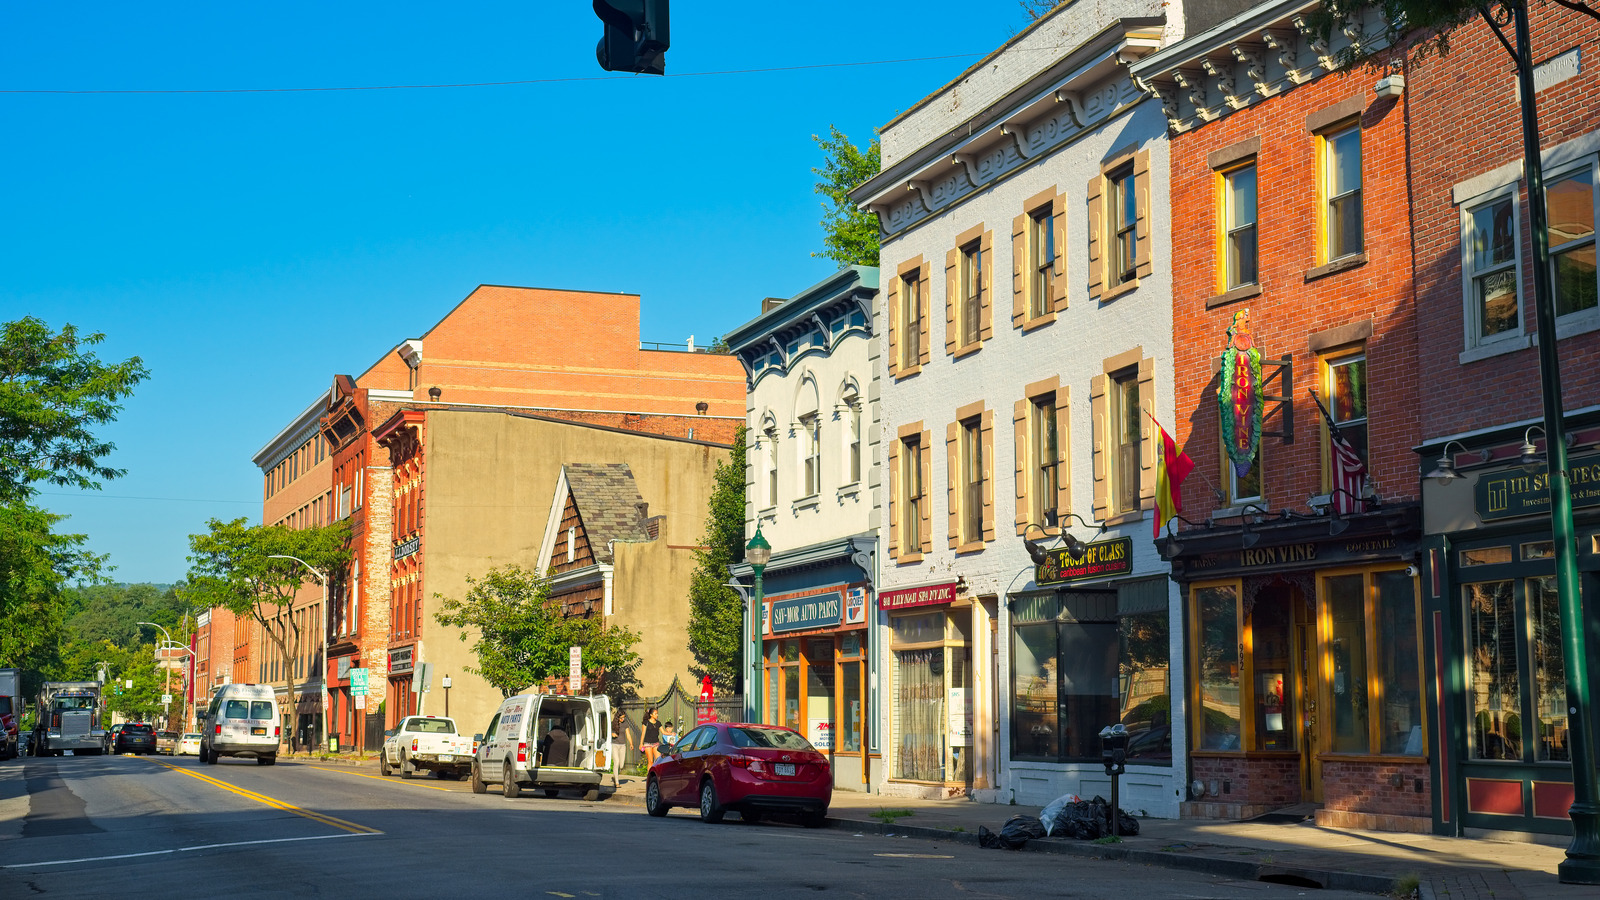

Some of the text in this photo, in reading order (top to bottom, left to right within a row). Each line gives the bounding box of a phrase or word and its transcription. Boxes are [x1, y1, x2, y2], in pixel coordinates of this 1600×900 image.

[1235, 354, 1251, 449] IRON VINE
[1510, 464, 1600, 494] ITI STTEG
[1087, 547, 1097, 563] OF
[1099, 542, 1125, 561] CLASS
[1346, 539, 1396, 552] COCKTAILS
[1240, 543, 1316, 567] IRON VINE
[1060, 567, 1087, 578] caribbean
[1087, 563, 1104, 574] fusion
[1105, 560, 1126, 571] cuisine
[1192, 558, 1216, 568] TAPAS
[847, 596, 864, 607] CARQUEST
[918, 590, 929, 602] SPA
[929, 589, 939, 601] NY
[800, 602, 817, 621] AUTO
[818, 599, 838, 619] PARTS
[510, 714, 522, 723] PARTS
[816, 722, 835, 730] AMS
